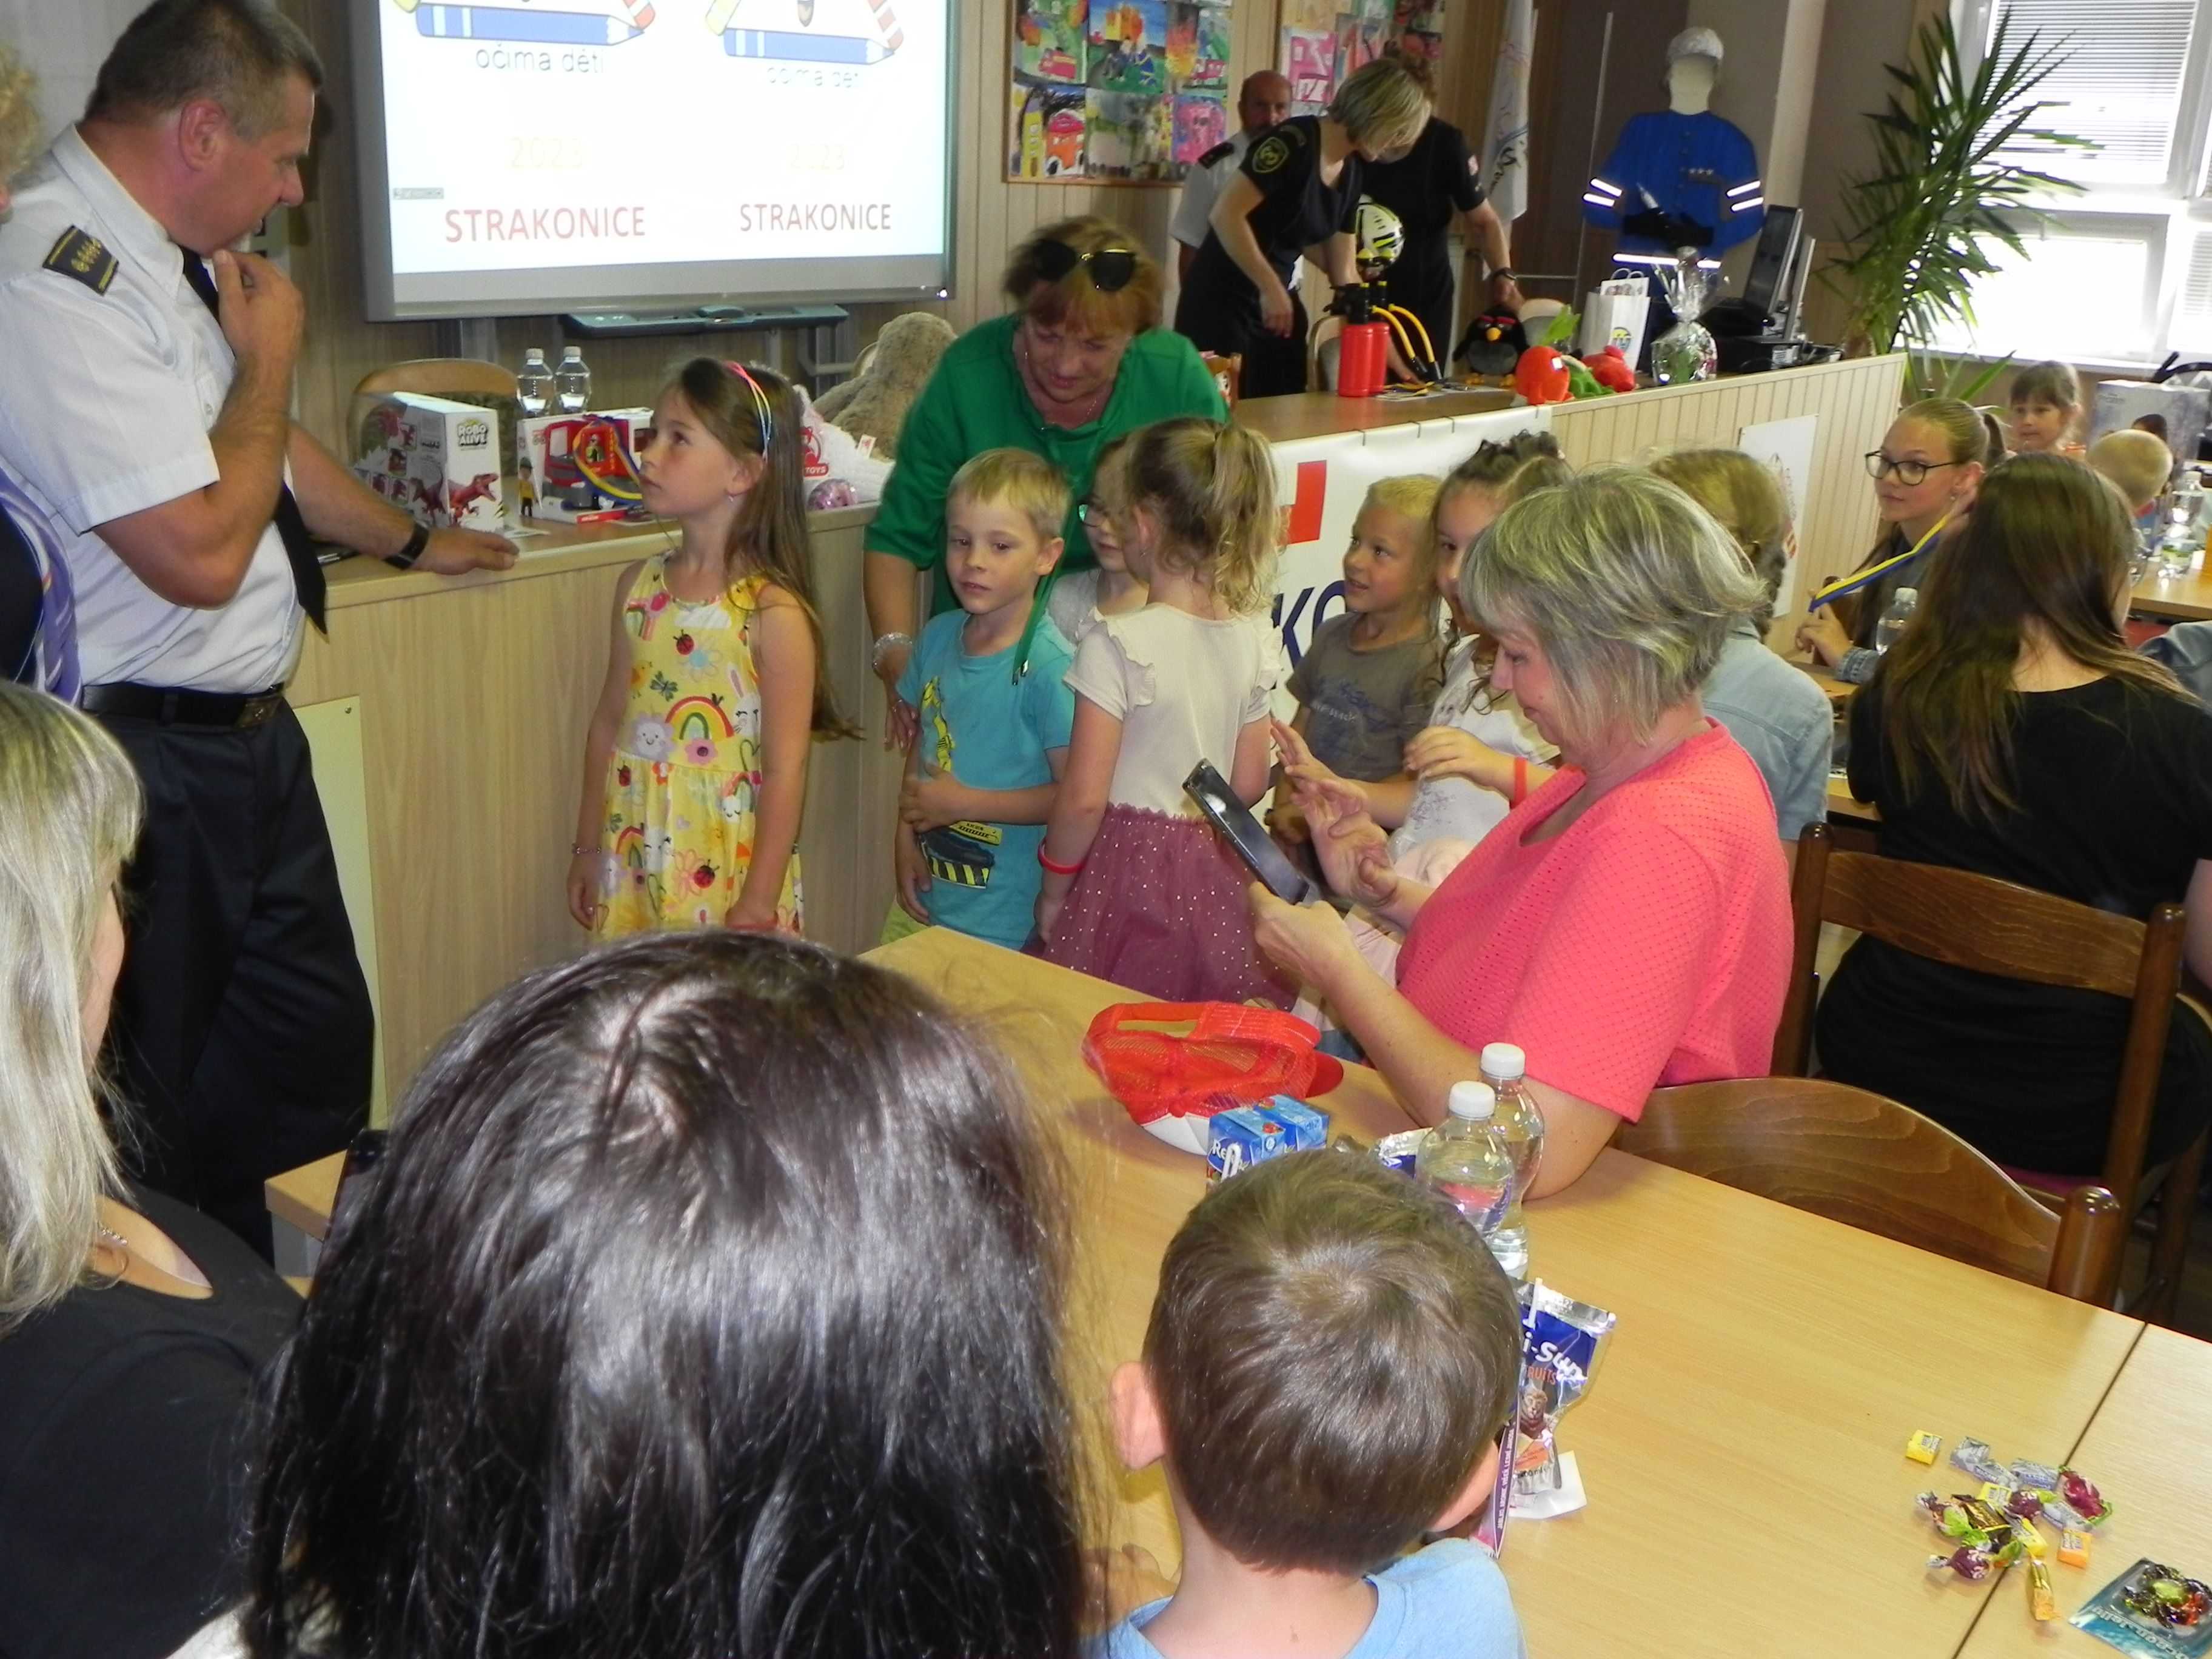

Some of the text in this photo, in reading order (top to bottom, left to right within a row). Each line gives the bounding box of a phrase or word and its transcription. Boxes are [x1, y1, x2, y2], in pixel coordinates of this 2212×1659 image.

[510, 136, 583, 169] 2023
[444, 206, 646, 243] STRAKONICE
[739, 203, 891, 232] STRAKONICE
[457, 424, 488, 436] ROBO
